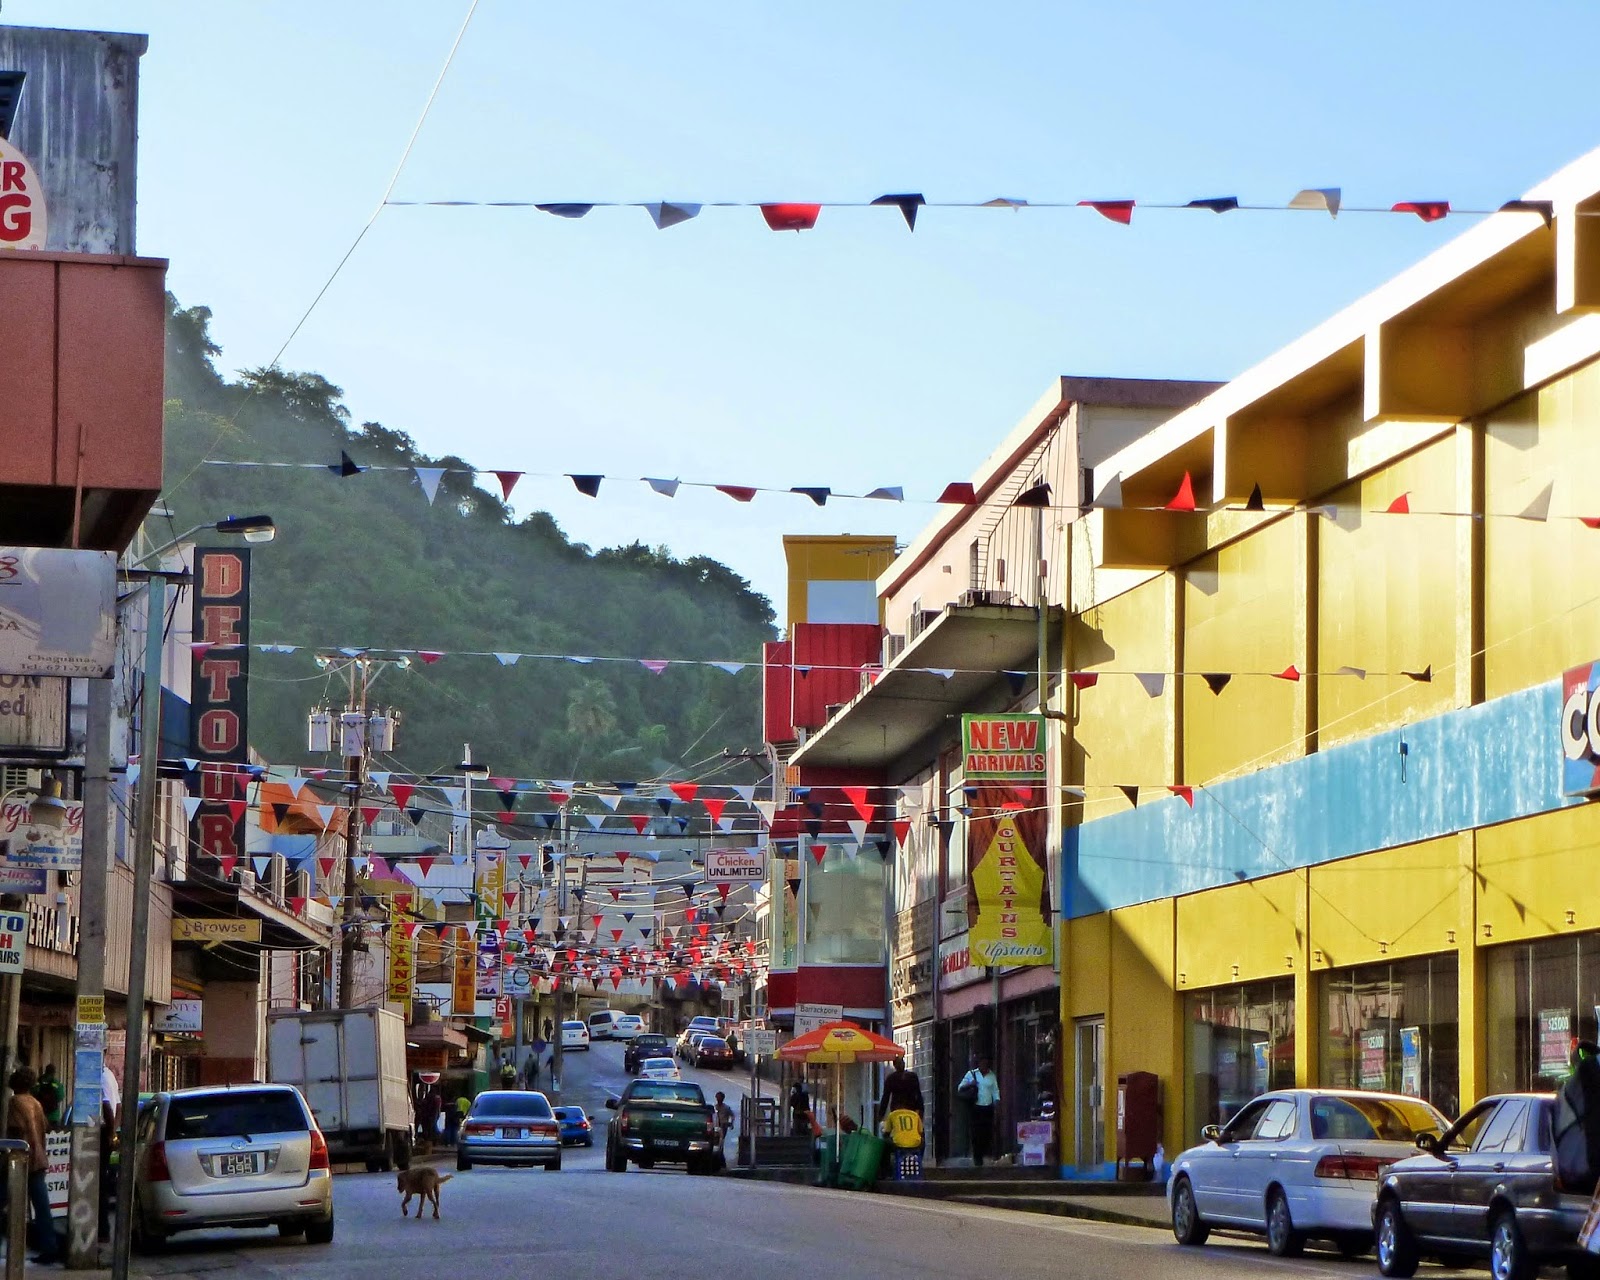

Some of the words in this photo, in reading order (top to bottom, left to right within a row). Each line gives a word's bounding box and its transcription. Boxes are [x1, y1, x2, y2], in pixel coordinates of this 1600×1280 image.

[200, 554, 242, 858] DETOUR
[970, 720, 1039, 750] NEW
[966, 754, 1045, 772] ARRIVALS
[717, 856, 755, 866] Chicken
[709, 867, 763, 876] UNLIMITED
[998, 828, 1018, 938] CURTAINS
[983, 941, 1044, 964] Upstairs
[800, 1005, 838, 1015] Barrackpore
[899, 1115, 912, 1131] 10
